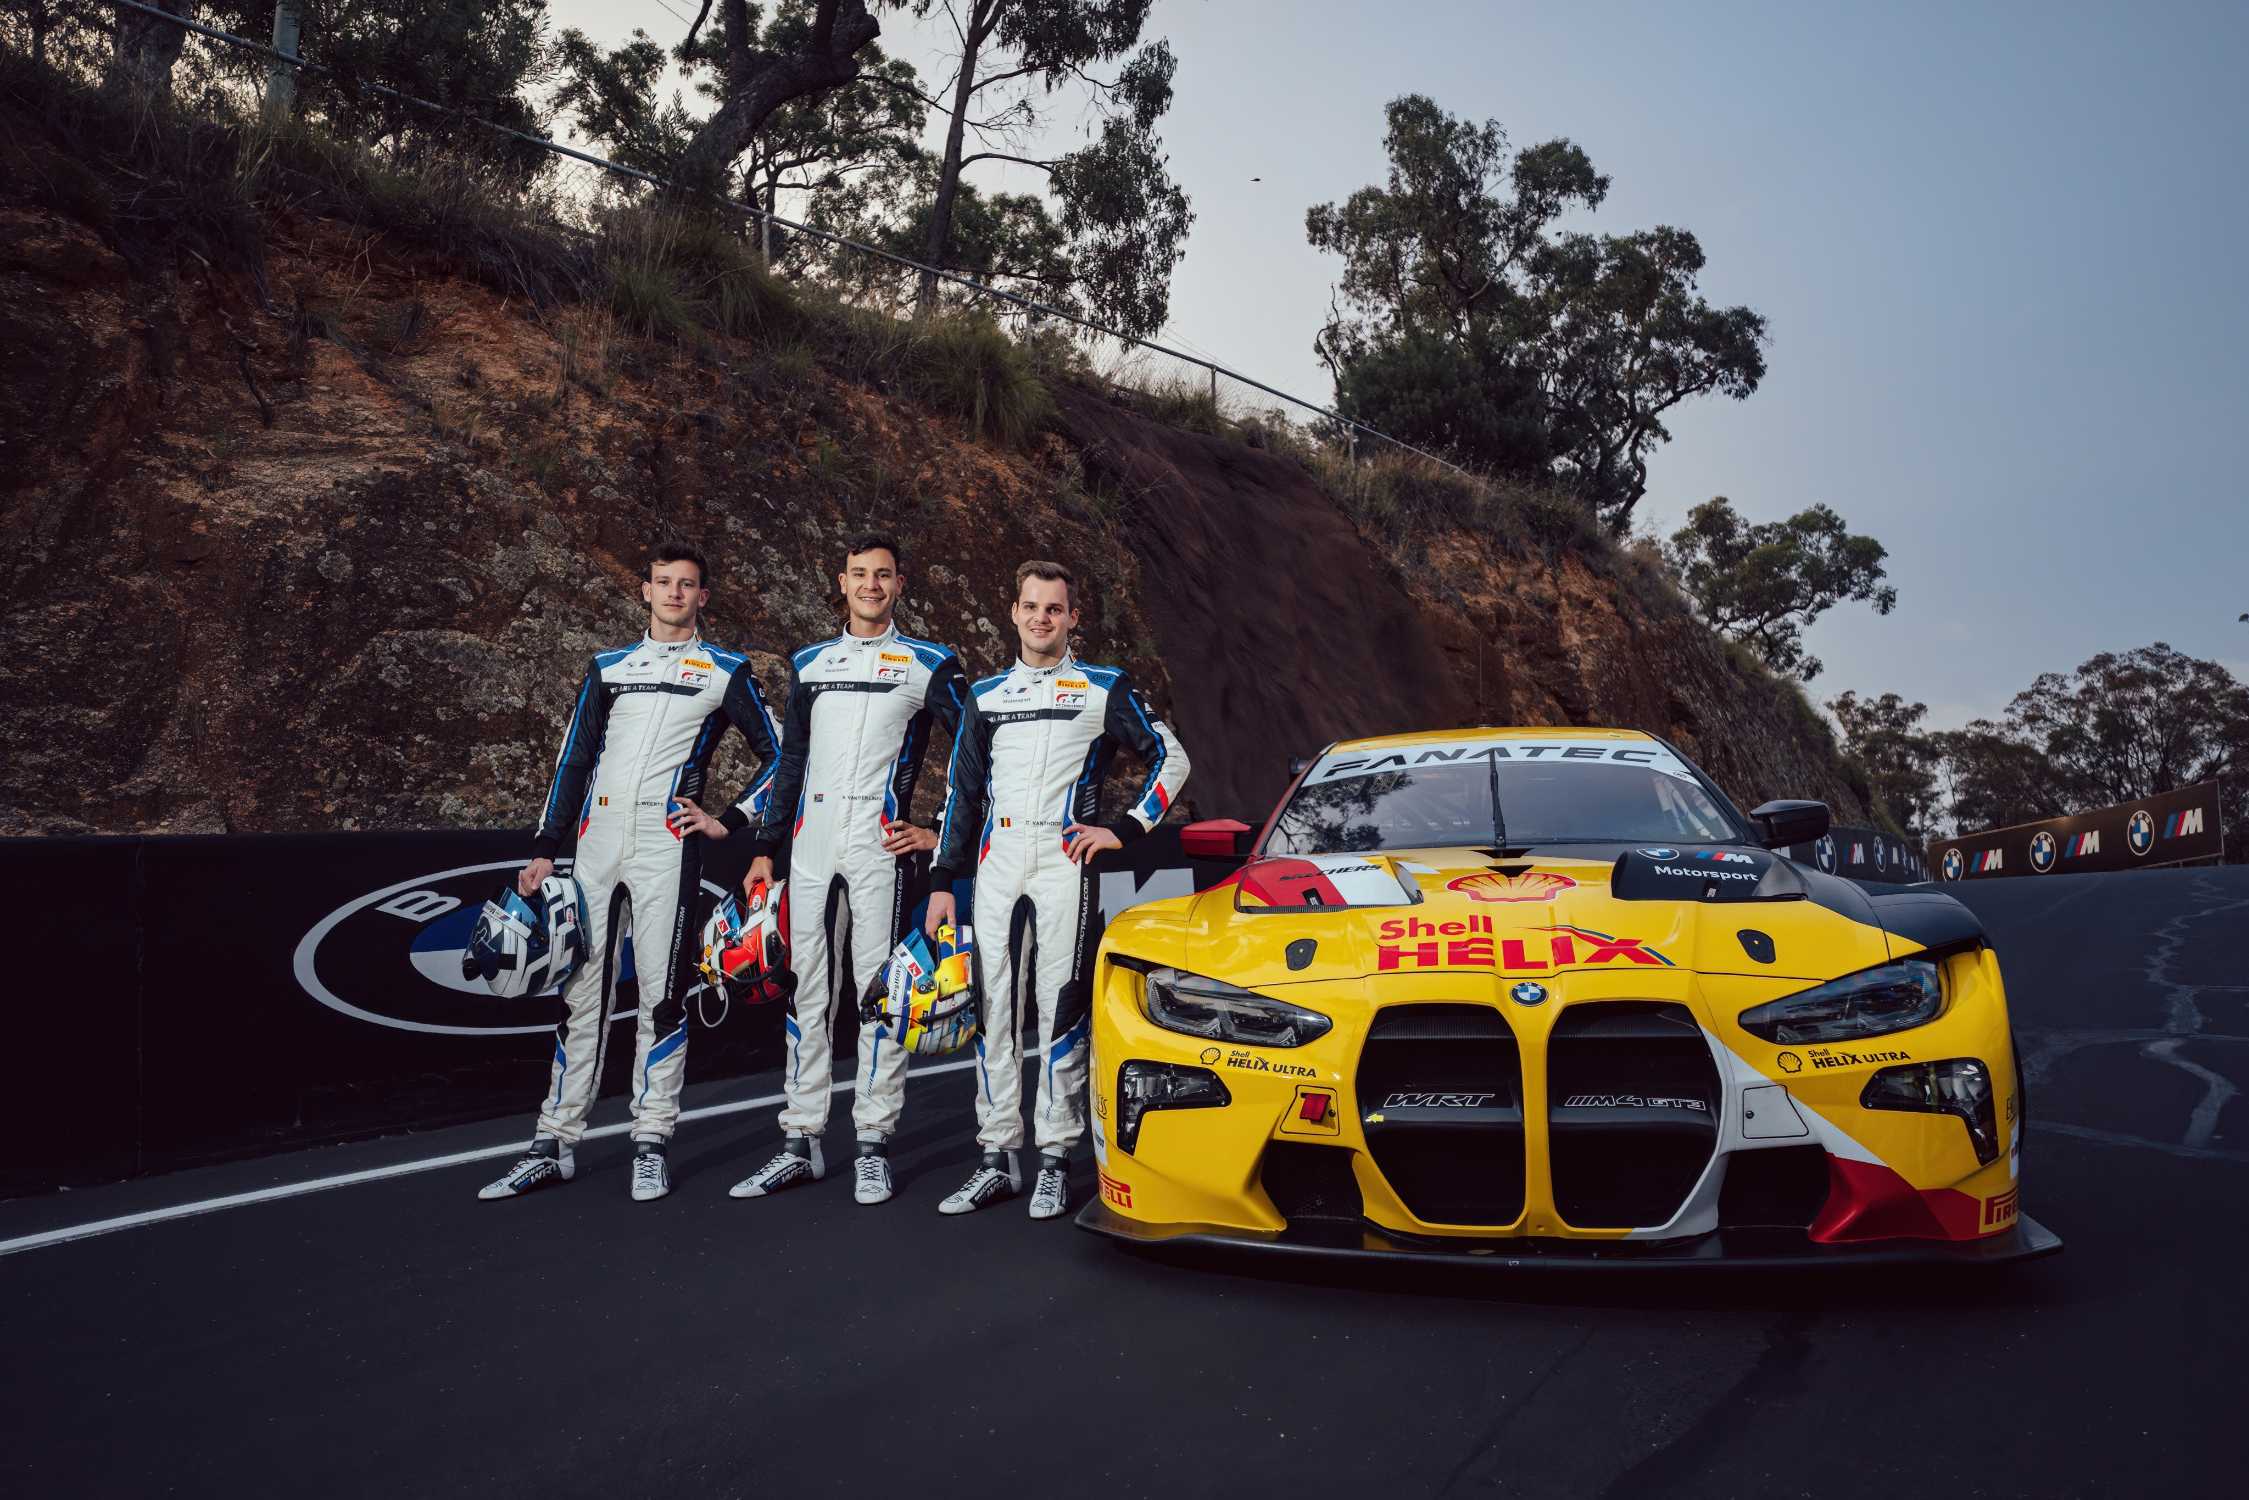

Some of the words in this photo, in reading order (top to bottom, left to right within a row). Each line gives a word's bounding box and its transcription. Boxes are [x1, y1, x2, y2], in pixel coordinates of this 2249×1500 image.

[1018, 712, 1036, 720] TEAM
[1323, 746, 1658, 778] FANATEC
[1654, 865, 1760, 881] Motorsport
[1379, 914, 1494, 941] Shell
[1378, 927, 1668, 971] HELIX
[1231, 1050, 1250, 1058] Shell
[1808, 1048, 1830, 1058] Shell
[1813, 1052, 1862, 1069] HELIX
[1863, 1051, 1912, 1063] ULTRA
[1227, 1056, 1269, 1072] HELIX
[1272, 1063, 1317, 1078] ULTRA
[1383, 1093, 1495, 1108] WRT
[1647, 1097, 1706, 1111] GT3
[1099, 1172, 1133, 1209] ELLI
